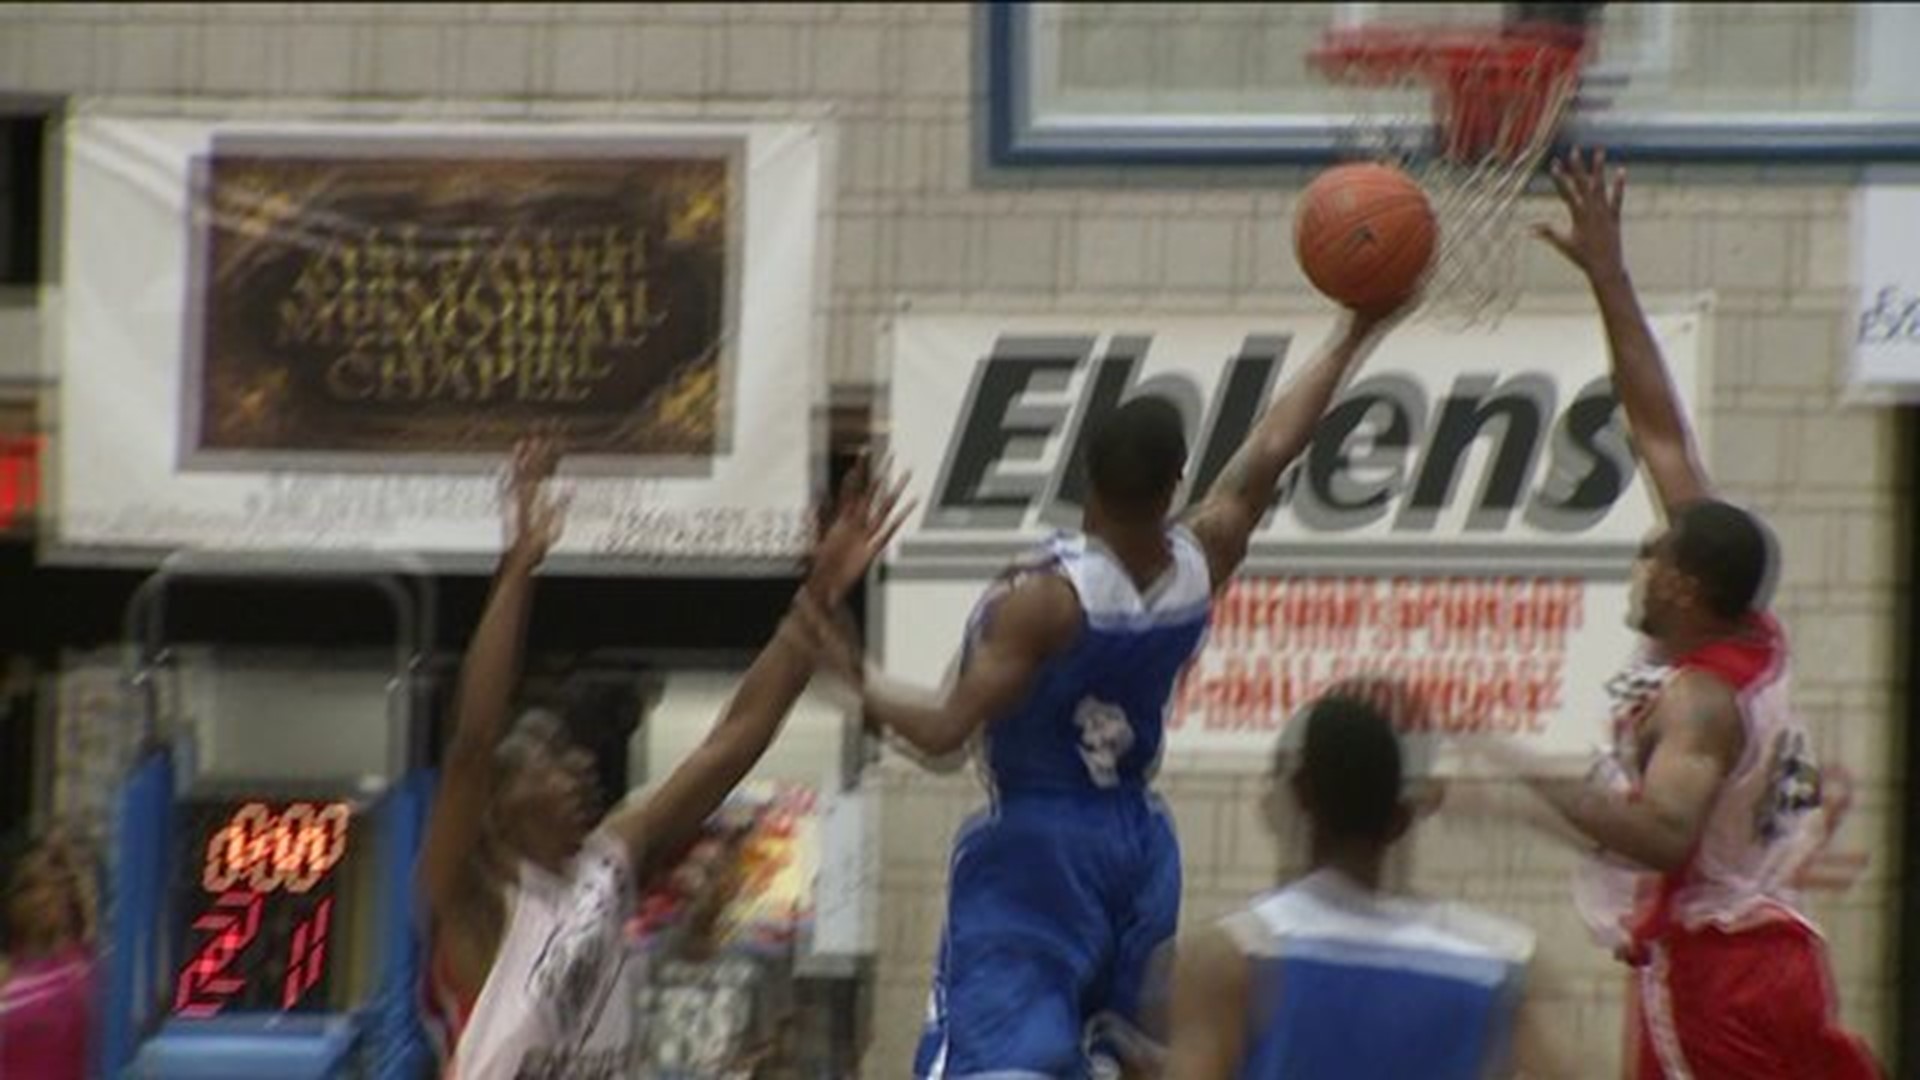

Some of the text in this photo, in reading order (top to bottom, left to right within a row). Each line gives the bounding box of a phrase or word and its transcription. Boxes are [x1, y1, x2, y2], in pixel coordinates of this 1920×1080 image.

[278, 276, 668, 349] MEMORIAL
[328, 330, 614, 400] CHAPEL
[1376, 578, 1584, 650] SPONSOR
